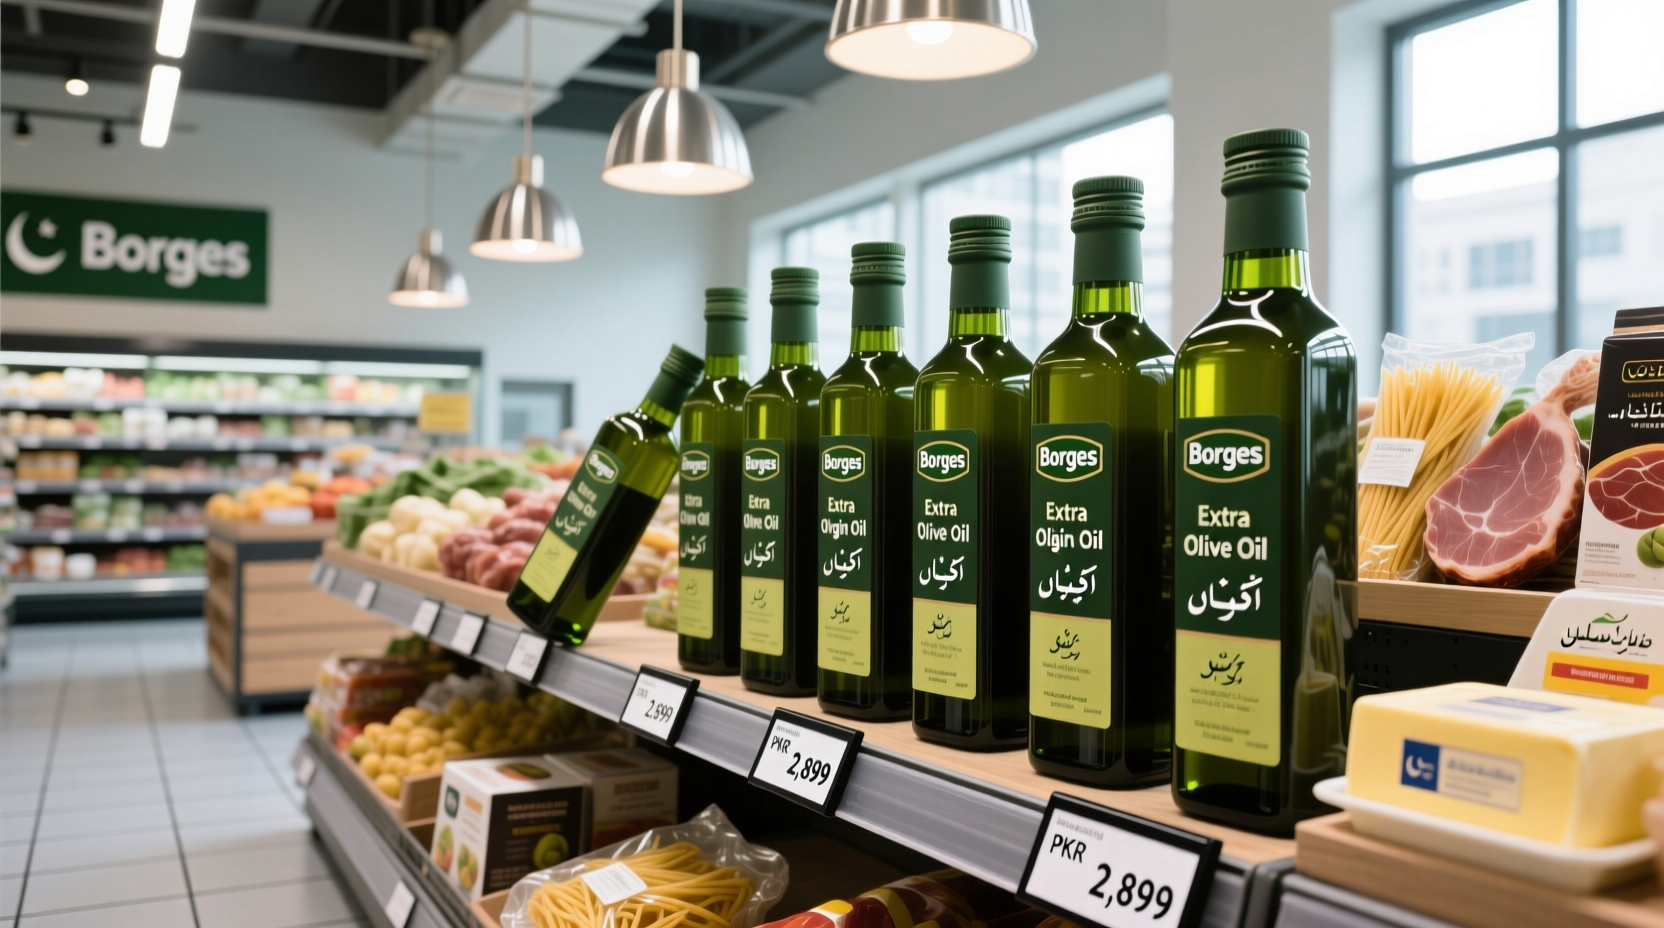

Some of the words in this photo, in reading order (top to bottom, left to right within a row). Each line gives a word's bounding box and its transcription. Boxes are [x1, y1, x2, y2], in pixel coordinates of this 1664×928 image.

[81, 220, 251, 288] Borges
[824, 453, 862, 475] Borges
[920, 450, 966, 474] Borges
[1040, 446, 1098, 472] Borges
[1189, 441, 1263, 471] Borges
[828, 497, 855, 513] Extra
[925, 499, 958, 516] Extra
[1046, 501, 1088, 522] Extra
[1197, 504, 1251, 528] Extra
[850, 519, 867, 537] Oil
[917, 522, 948, 542] Olive
[951, 523, 970, 543] Oil
[1079, 531, 1103, 550] Oil
[1183, 534, 1233, 559] Olive
[1236, 536, 1268, 561] Oil
[770, 735, 791, 755] PKR
[786, 751, 832, 786] 2,899
[1049, 833, 1087, 864] PKR
[1088, 862, 1174, 920] 2,899
